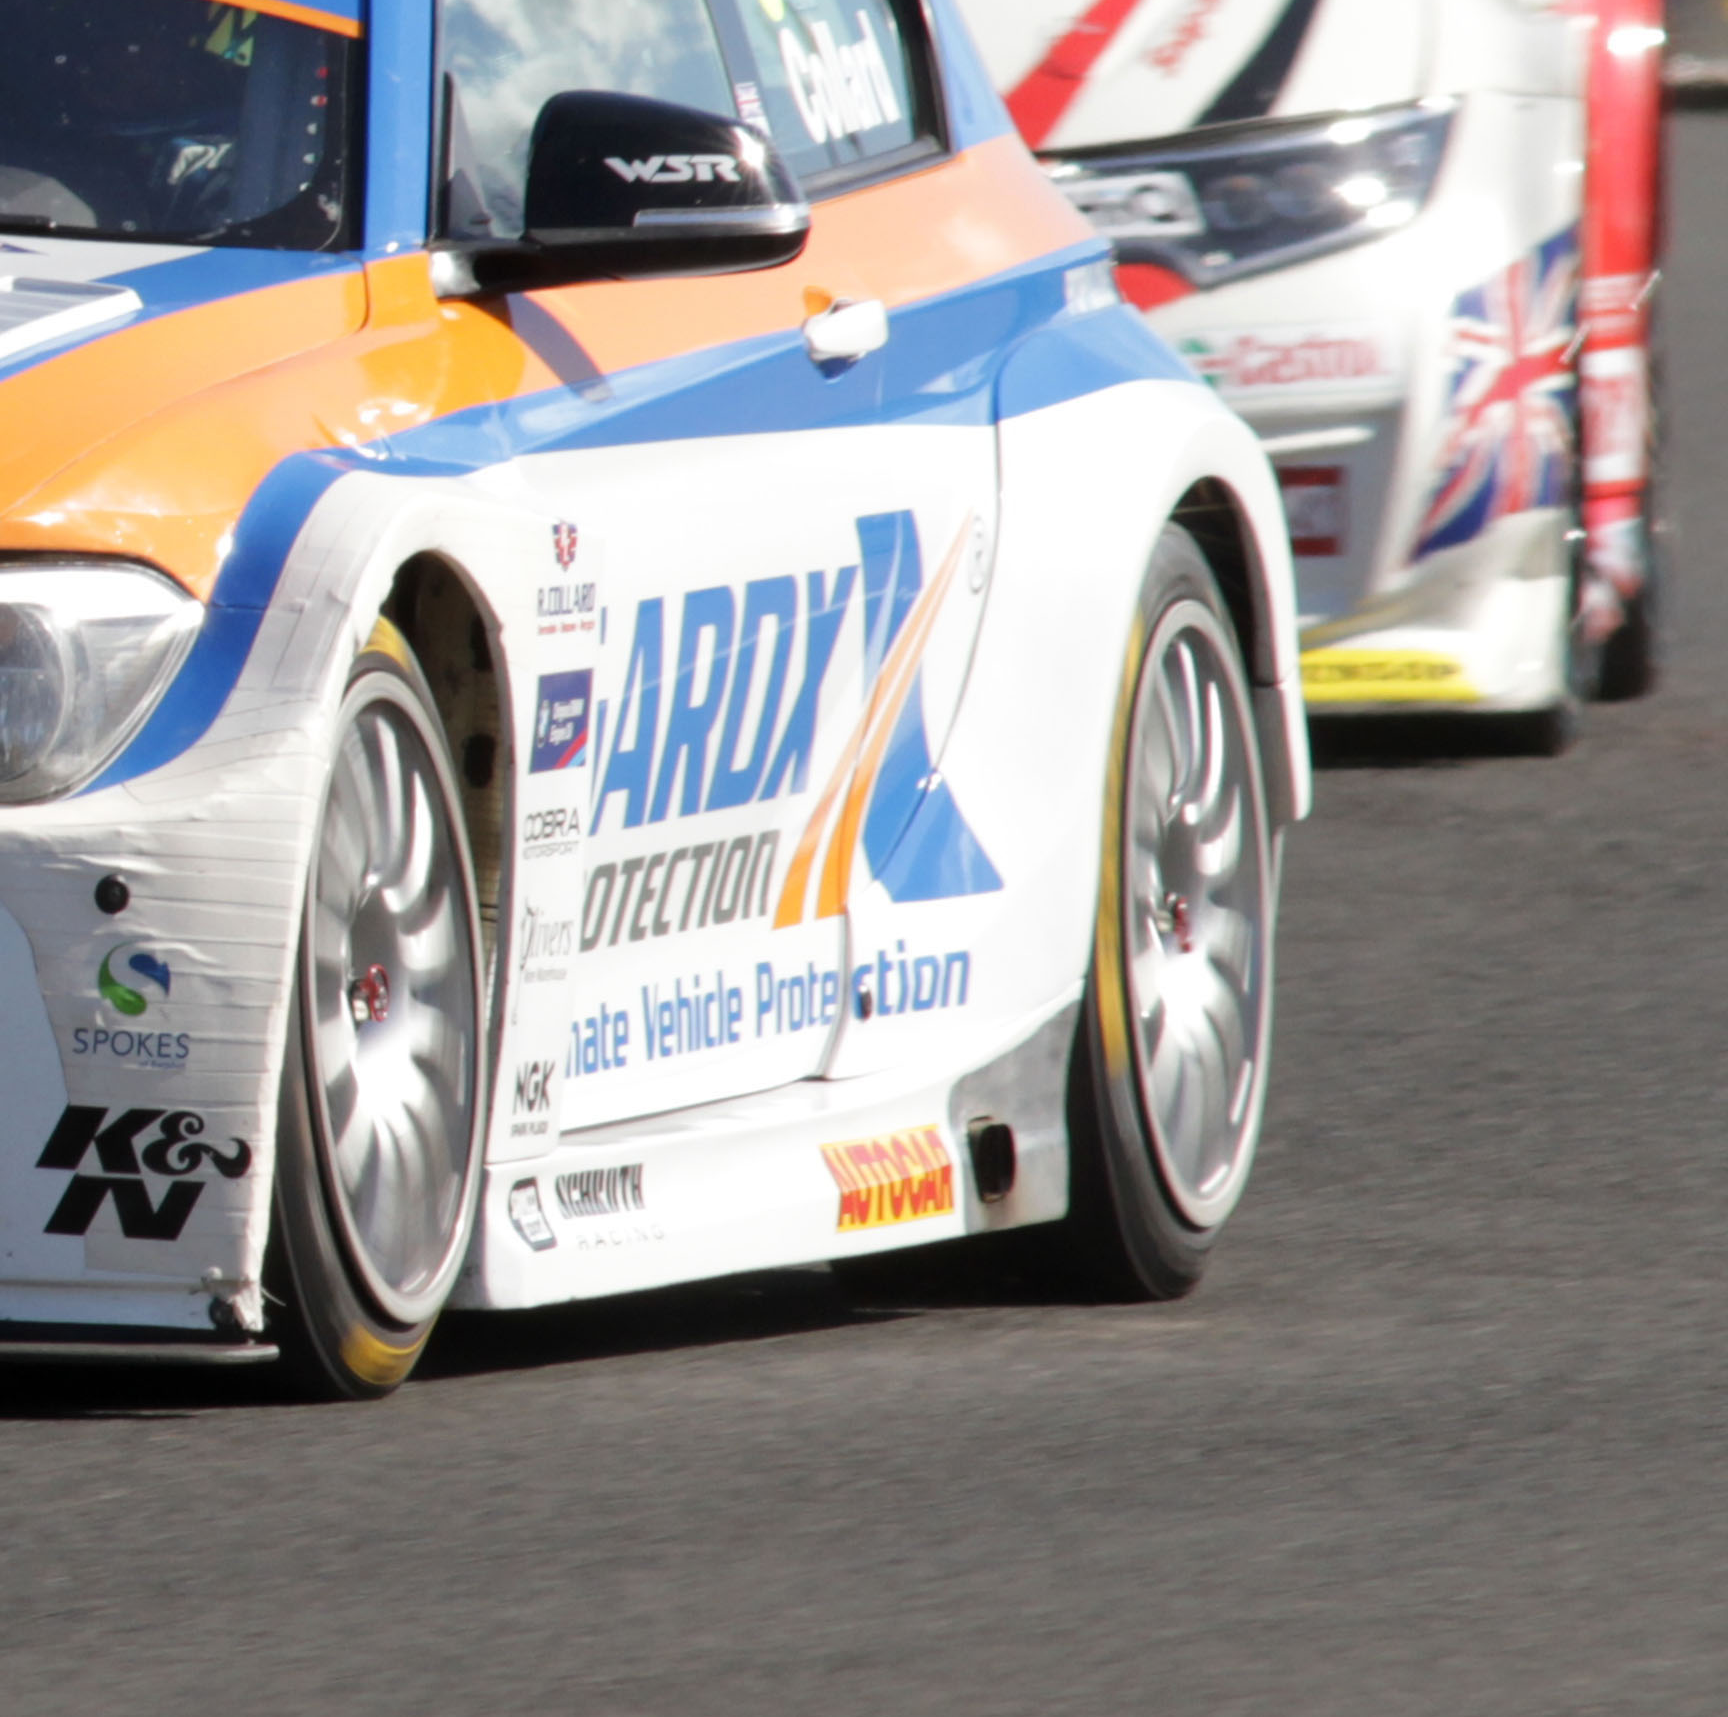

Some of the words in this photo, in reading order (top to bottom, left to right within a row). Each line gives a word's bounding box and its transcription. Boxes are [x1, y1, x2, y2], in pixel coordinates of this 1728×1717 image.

[604, 154, 743, 183] WSR
[589, 565, 860, 836] ARDX
[523, 808, 581, 843] COBRA
[641, 970, 743, 1061] Vehicle
[756, 940, 971, 1039] Protection
[72, 1027, 191, 1059] SPOKES
[512, 1060, 556, 1116] NGK
